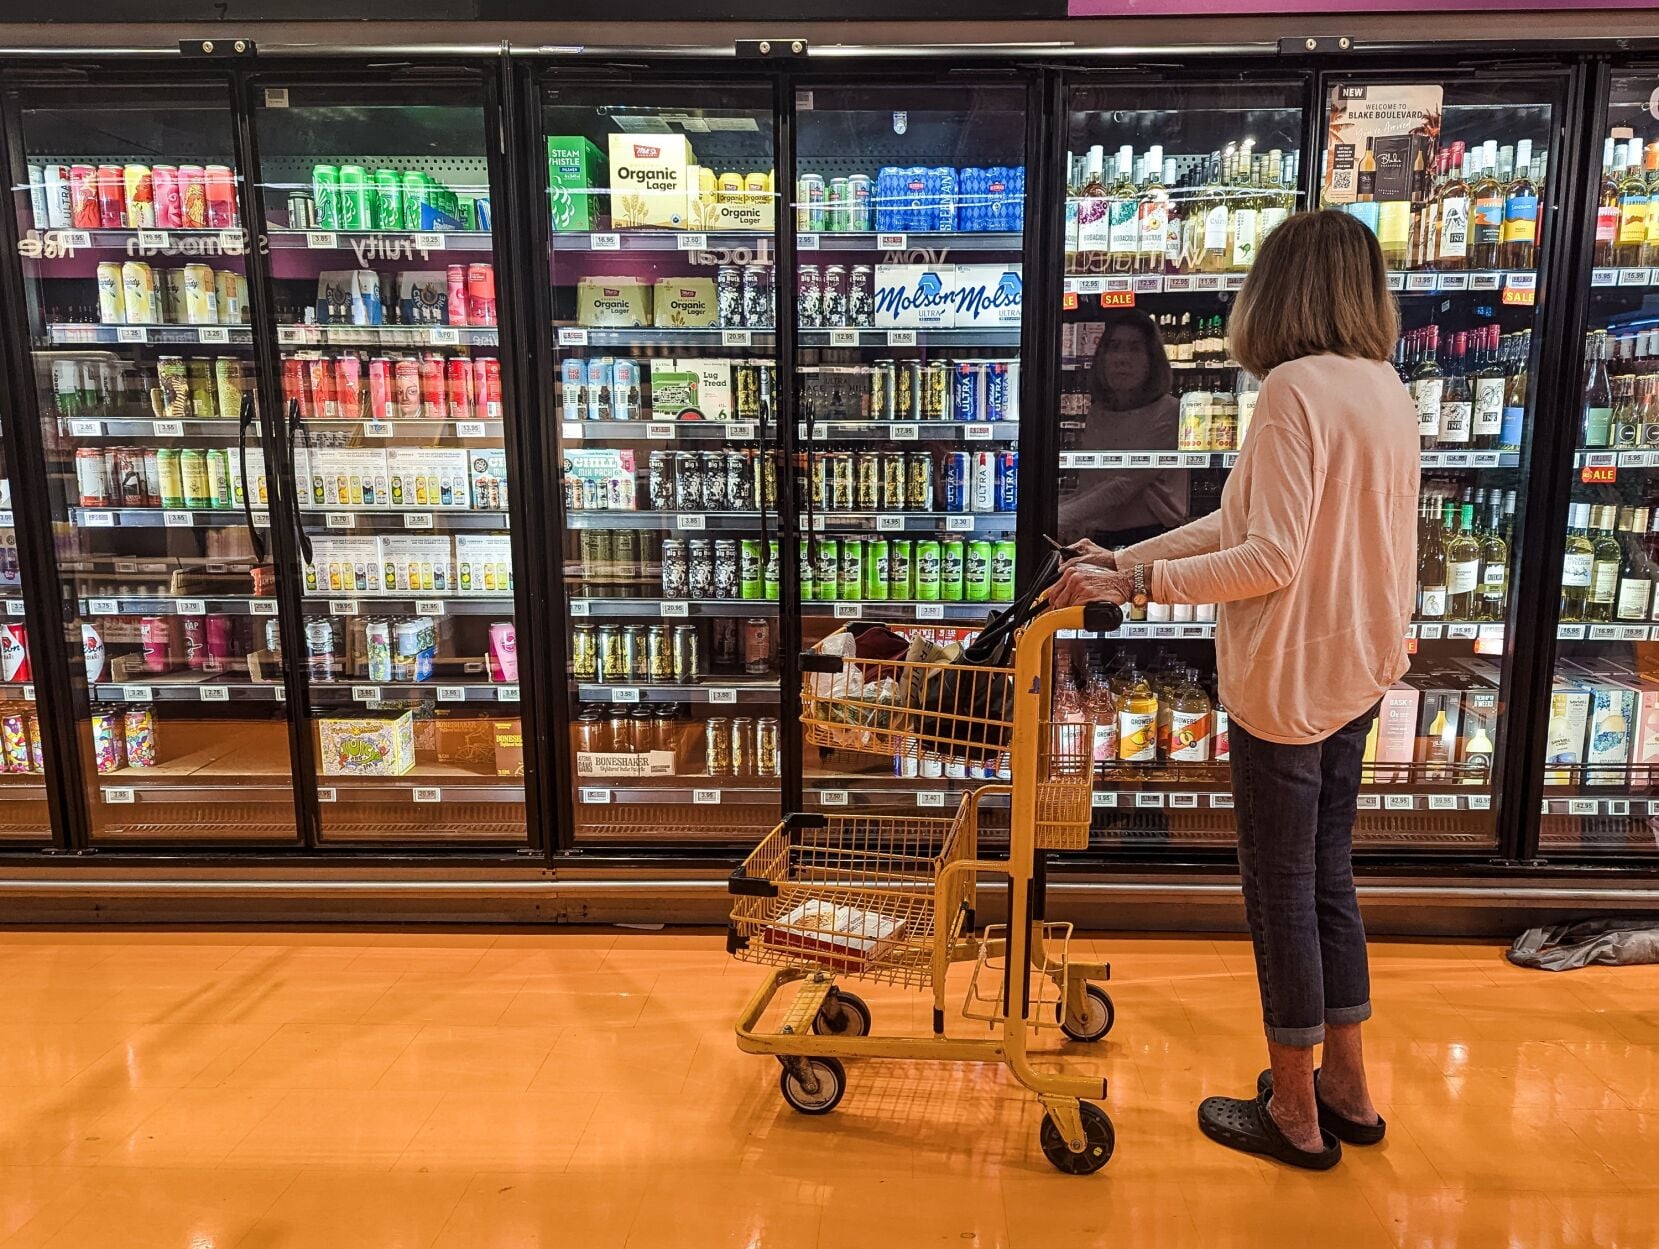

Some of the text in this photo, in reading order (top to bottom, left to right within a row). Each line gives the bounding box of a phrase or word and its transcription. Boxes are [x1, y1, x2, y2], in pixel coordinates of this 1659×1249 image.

[1343, 88, 1363, 97] NEW
[1348, 111, 1423, 120] BLAKE BOULEVARD
[552, 150, 580, 160] STEAM
[618, 167, 677, 182] Organic
[647, 182, 677, 191] Lager
[721, 207, 761, 220] Organic
[740, 216, 761, 225] Lager
[1064, 296, 1074, 306] LE
[1105, 295, 1132, 305] SALE
[1507, 291, 1534, 303] SALE
[594, 300, 629, 310] Organic
[671, 301, 705, 311] Organic
[875, 285, 956, 320] Molson
[955, 285, 1022, 320] Molso
[703, 371, 718, 381] Lug
[703, 380, 726, 388] Tread
[962, 377, 970, 411] ULTRA
[995, 377, 1003, 411] ULTRA
[947, 469, 955, 502] ULTRA
[978, 469, 986, 503] ULTRA
[1005, 469, 1014, 503] ULTRA
[595, 757, 649, 767] BONESHAKER
